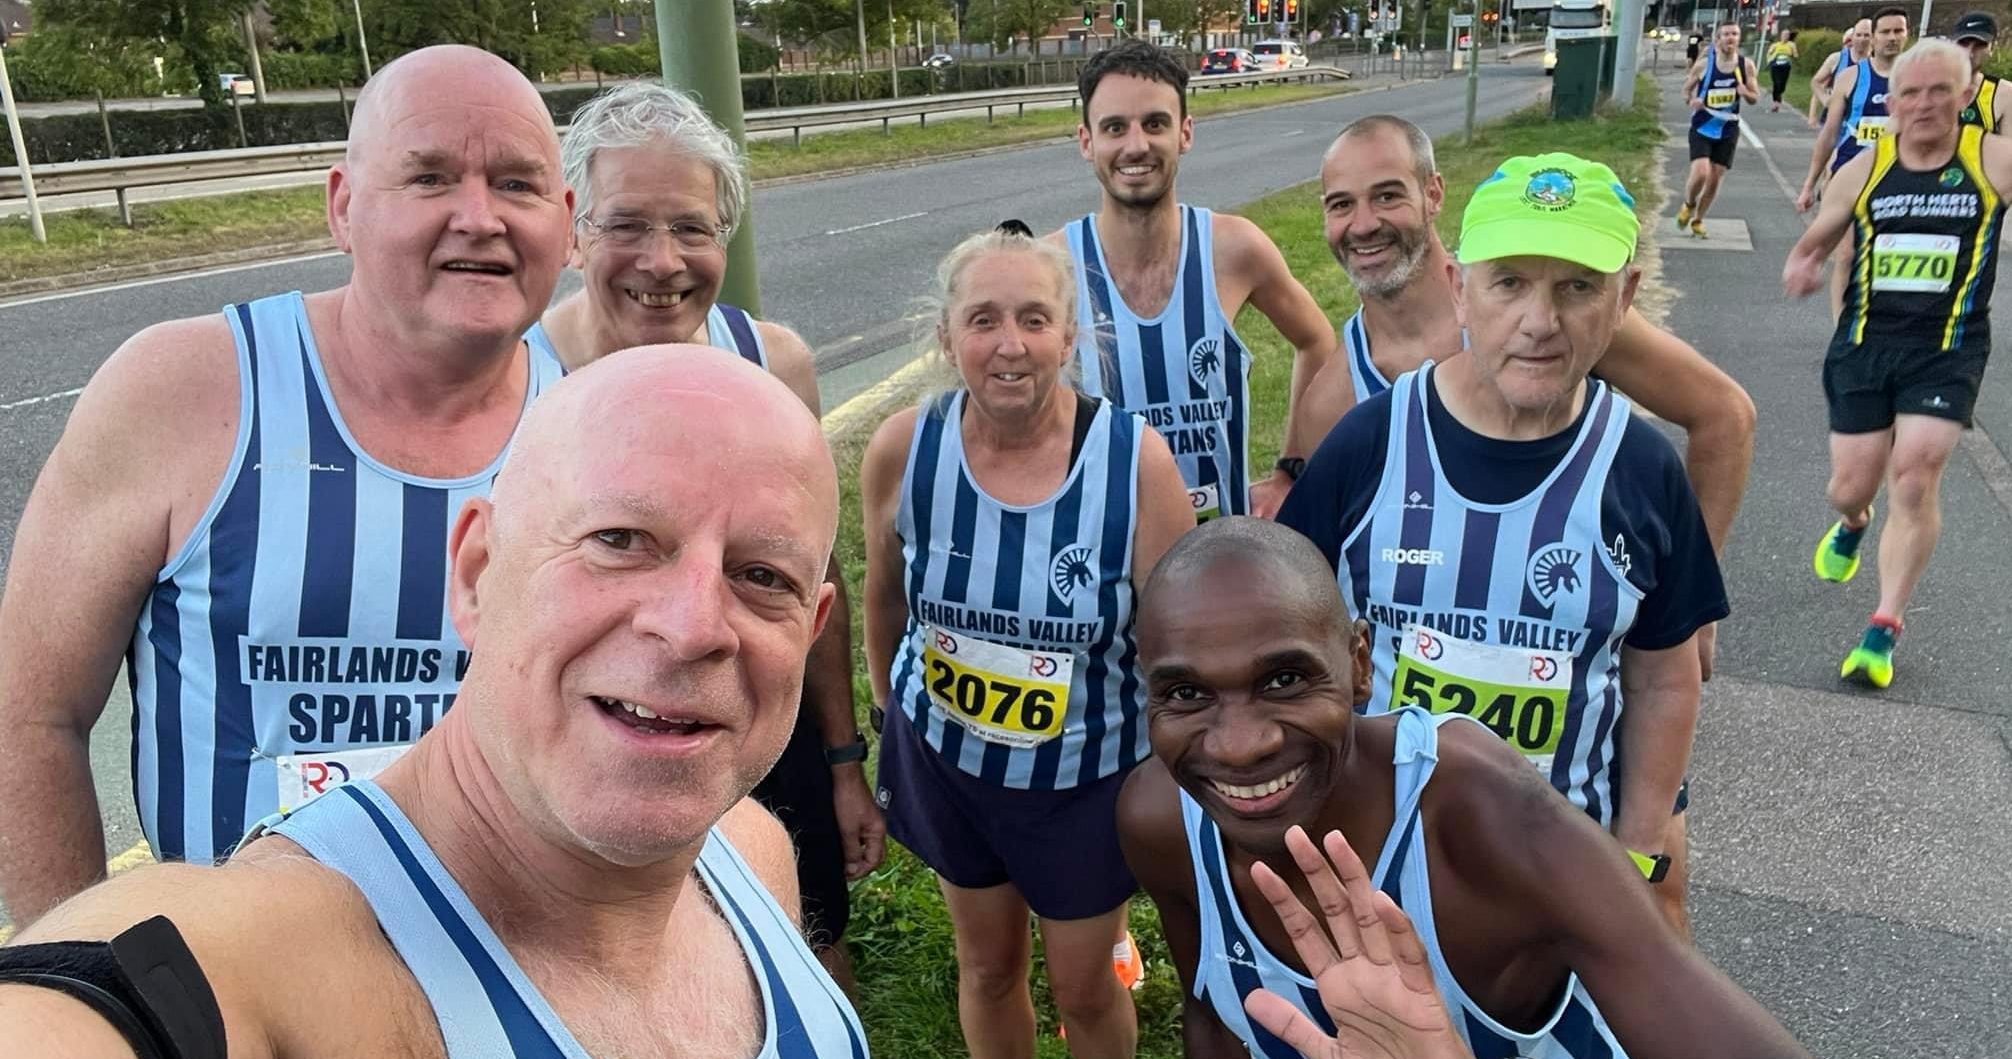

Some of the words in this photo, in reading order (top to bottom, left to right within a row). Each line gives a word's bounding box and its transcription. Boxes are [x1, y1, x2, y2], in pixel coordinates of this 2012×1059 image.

[1862, 127, 1885, 140] 15
[1871, 194, 1925, 210] NORTH
[1927, 194, 1978, 206] HERTS
[1910, 206, 1978, 218] RUNNERS
[1878, 253, 1949, 280] 5770
[1179, 400, 1228, 424] VALLEY
[1382, 549, 1444, 566] ROGER
[921, 600, 1021, 637] FAIRLANDS
[1028, 619, 1099, 644] VALLEY
[1498, 618, 1582, 651] VALLEY
[248, 645, 442, 684] FAIRLANDS
[931, 659, 1056, 732] 2076
[1401, 667, 1555, 750] 5240
